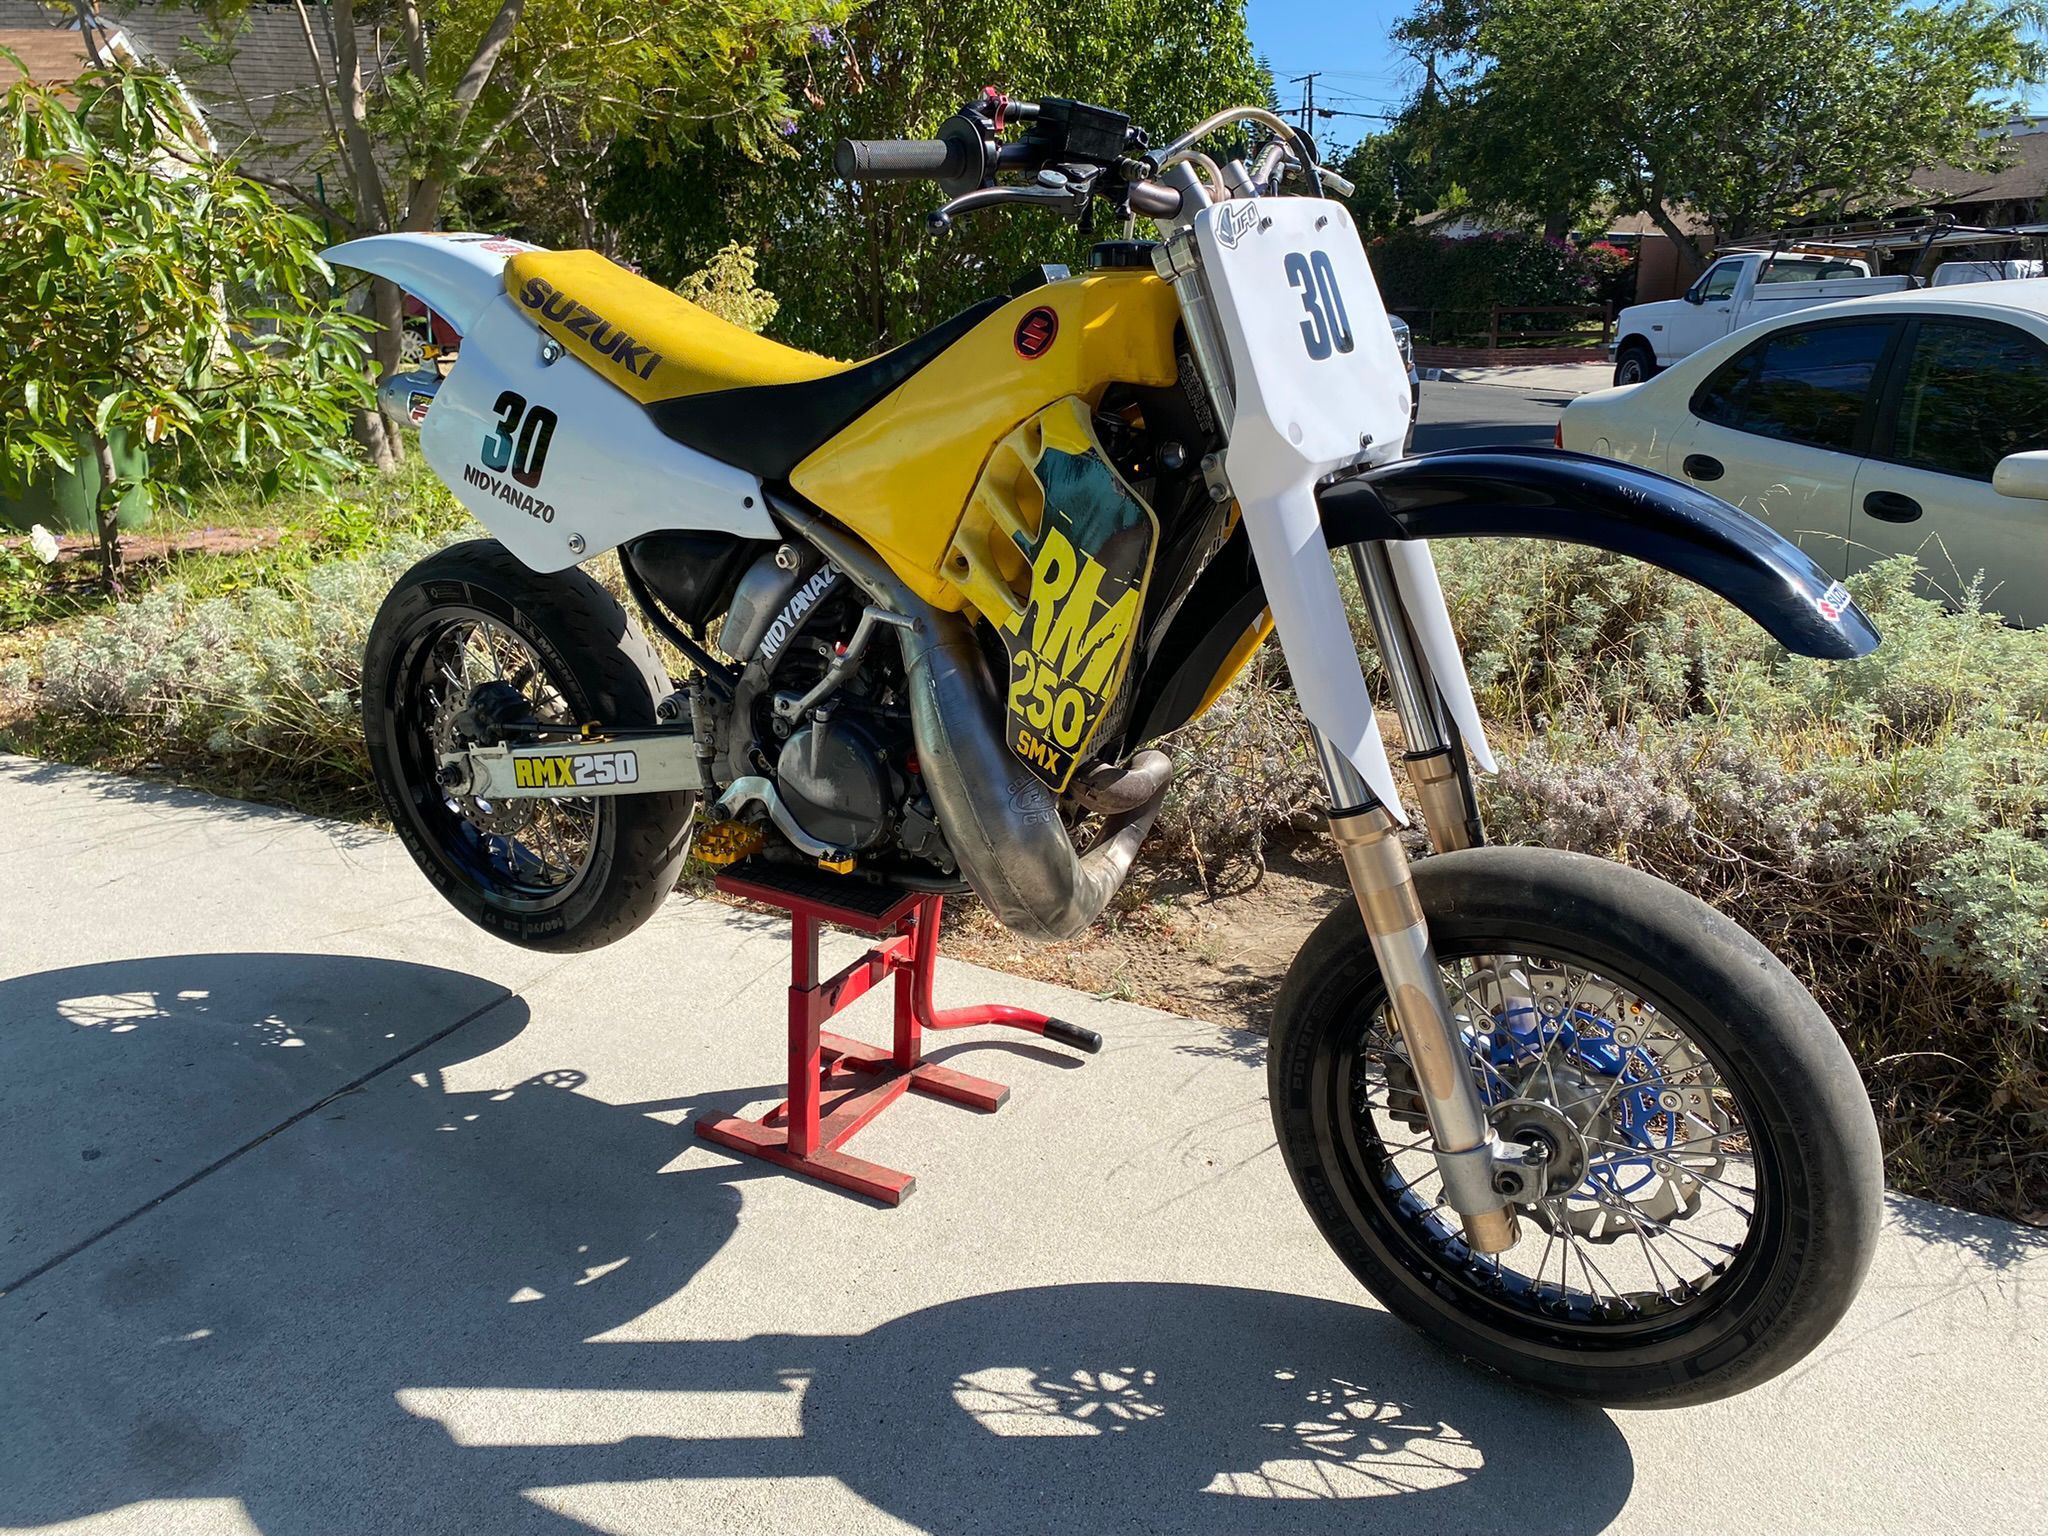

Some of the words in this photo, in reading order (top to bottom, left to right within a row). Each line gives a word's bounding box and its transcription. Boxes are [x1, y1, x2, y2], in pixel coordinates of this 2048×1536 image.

[1232, 205, 1256, 236] UFO
[519, 277, 664, 381] SUZUKI
[1284, 250, 1355, 361] 30
[480, 390, 558, 489] 30
[463, 463, 555, 524] NIDYANAZO
[1010, 649, 1086, 748] 250
[513, 751, 639, 788] RMX250
[1015, 729, 1060, 775] SMX
